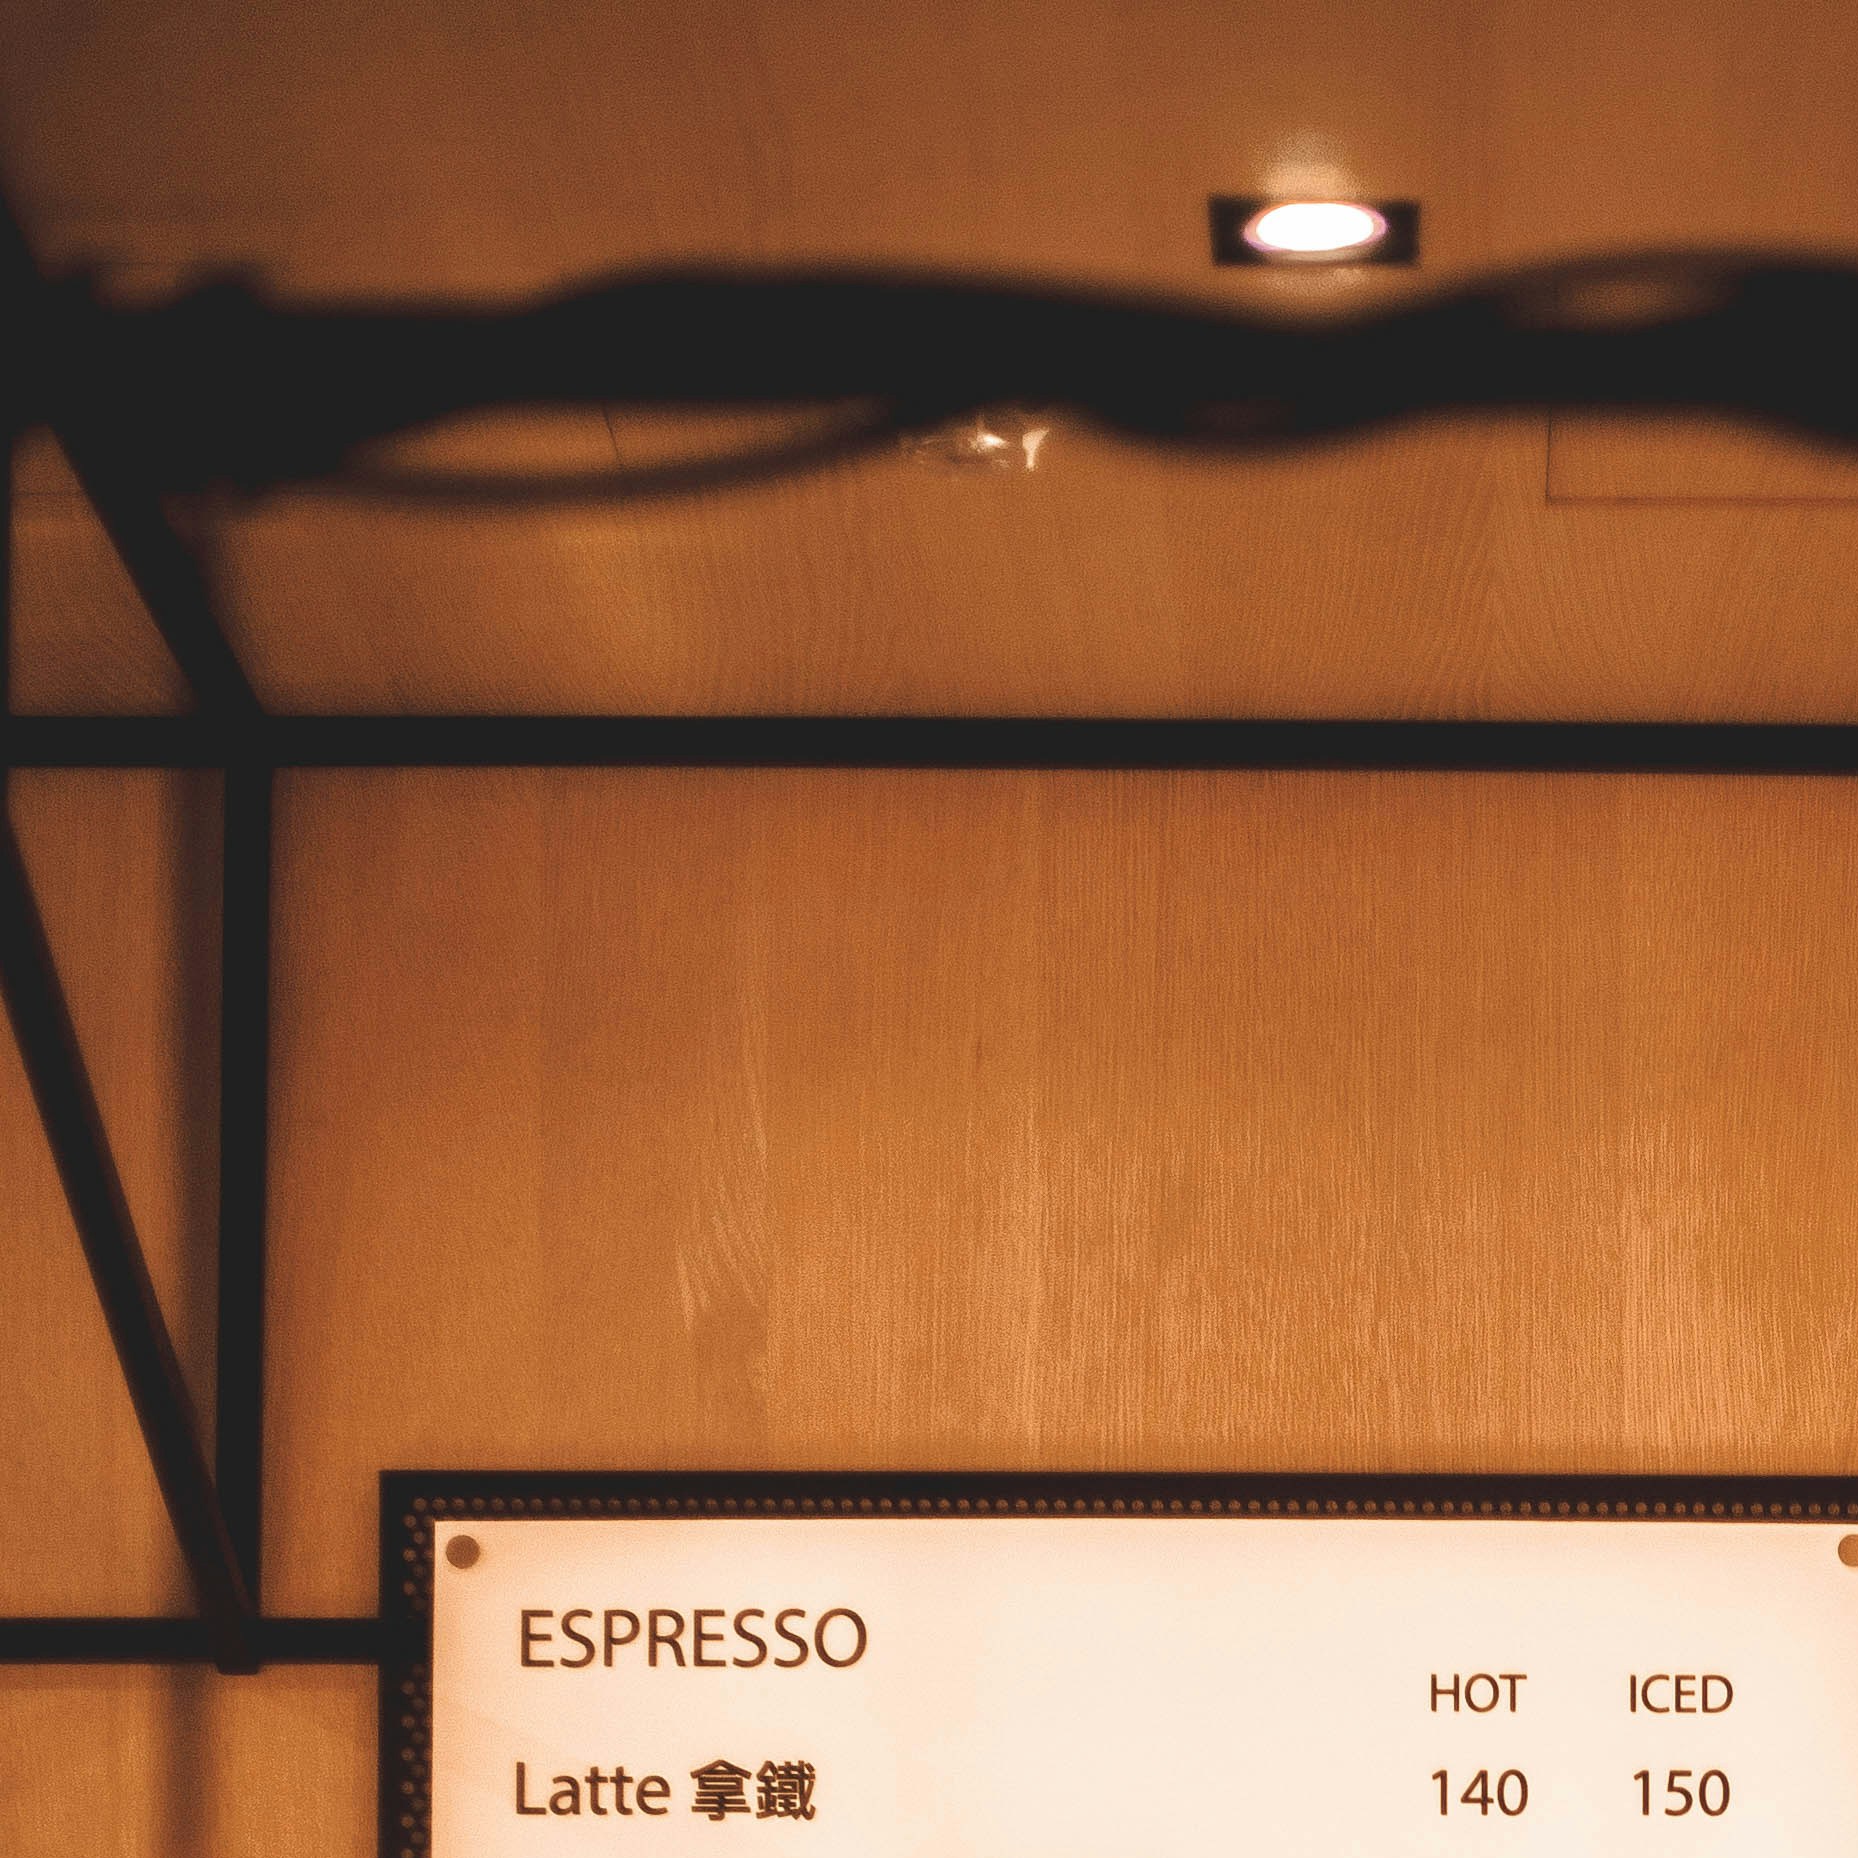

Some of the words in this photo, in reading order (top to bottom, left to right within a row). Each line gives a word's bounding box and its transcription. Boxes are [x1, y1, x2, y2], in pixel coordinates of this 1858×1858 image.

[520, 1607, 868, 1669] ESPRESSO
[1430, 1673, 1528, 1713] HOT
[1629, 1673, 1734, 1714] ICED
[515, 1761, 671, 1816] Latte
[689, 1759, 817, 1822] 拿鐵
[1431, 1768, 1529, 1817] 140
[1633, 1769, 1731, 1817] 150
